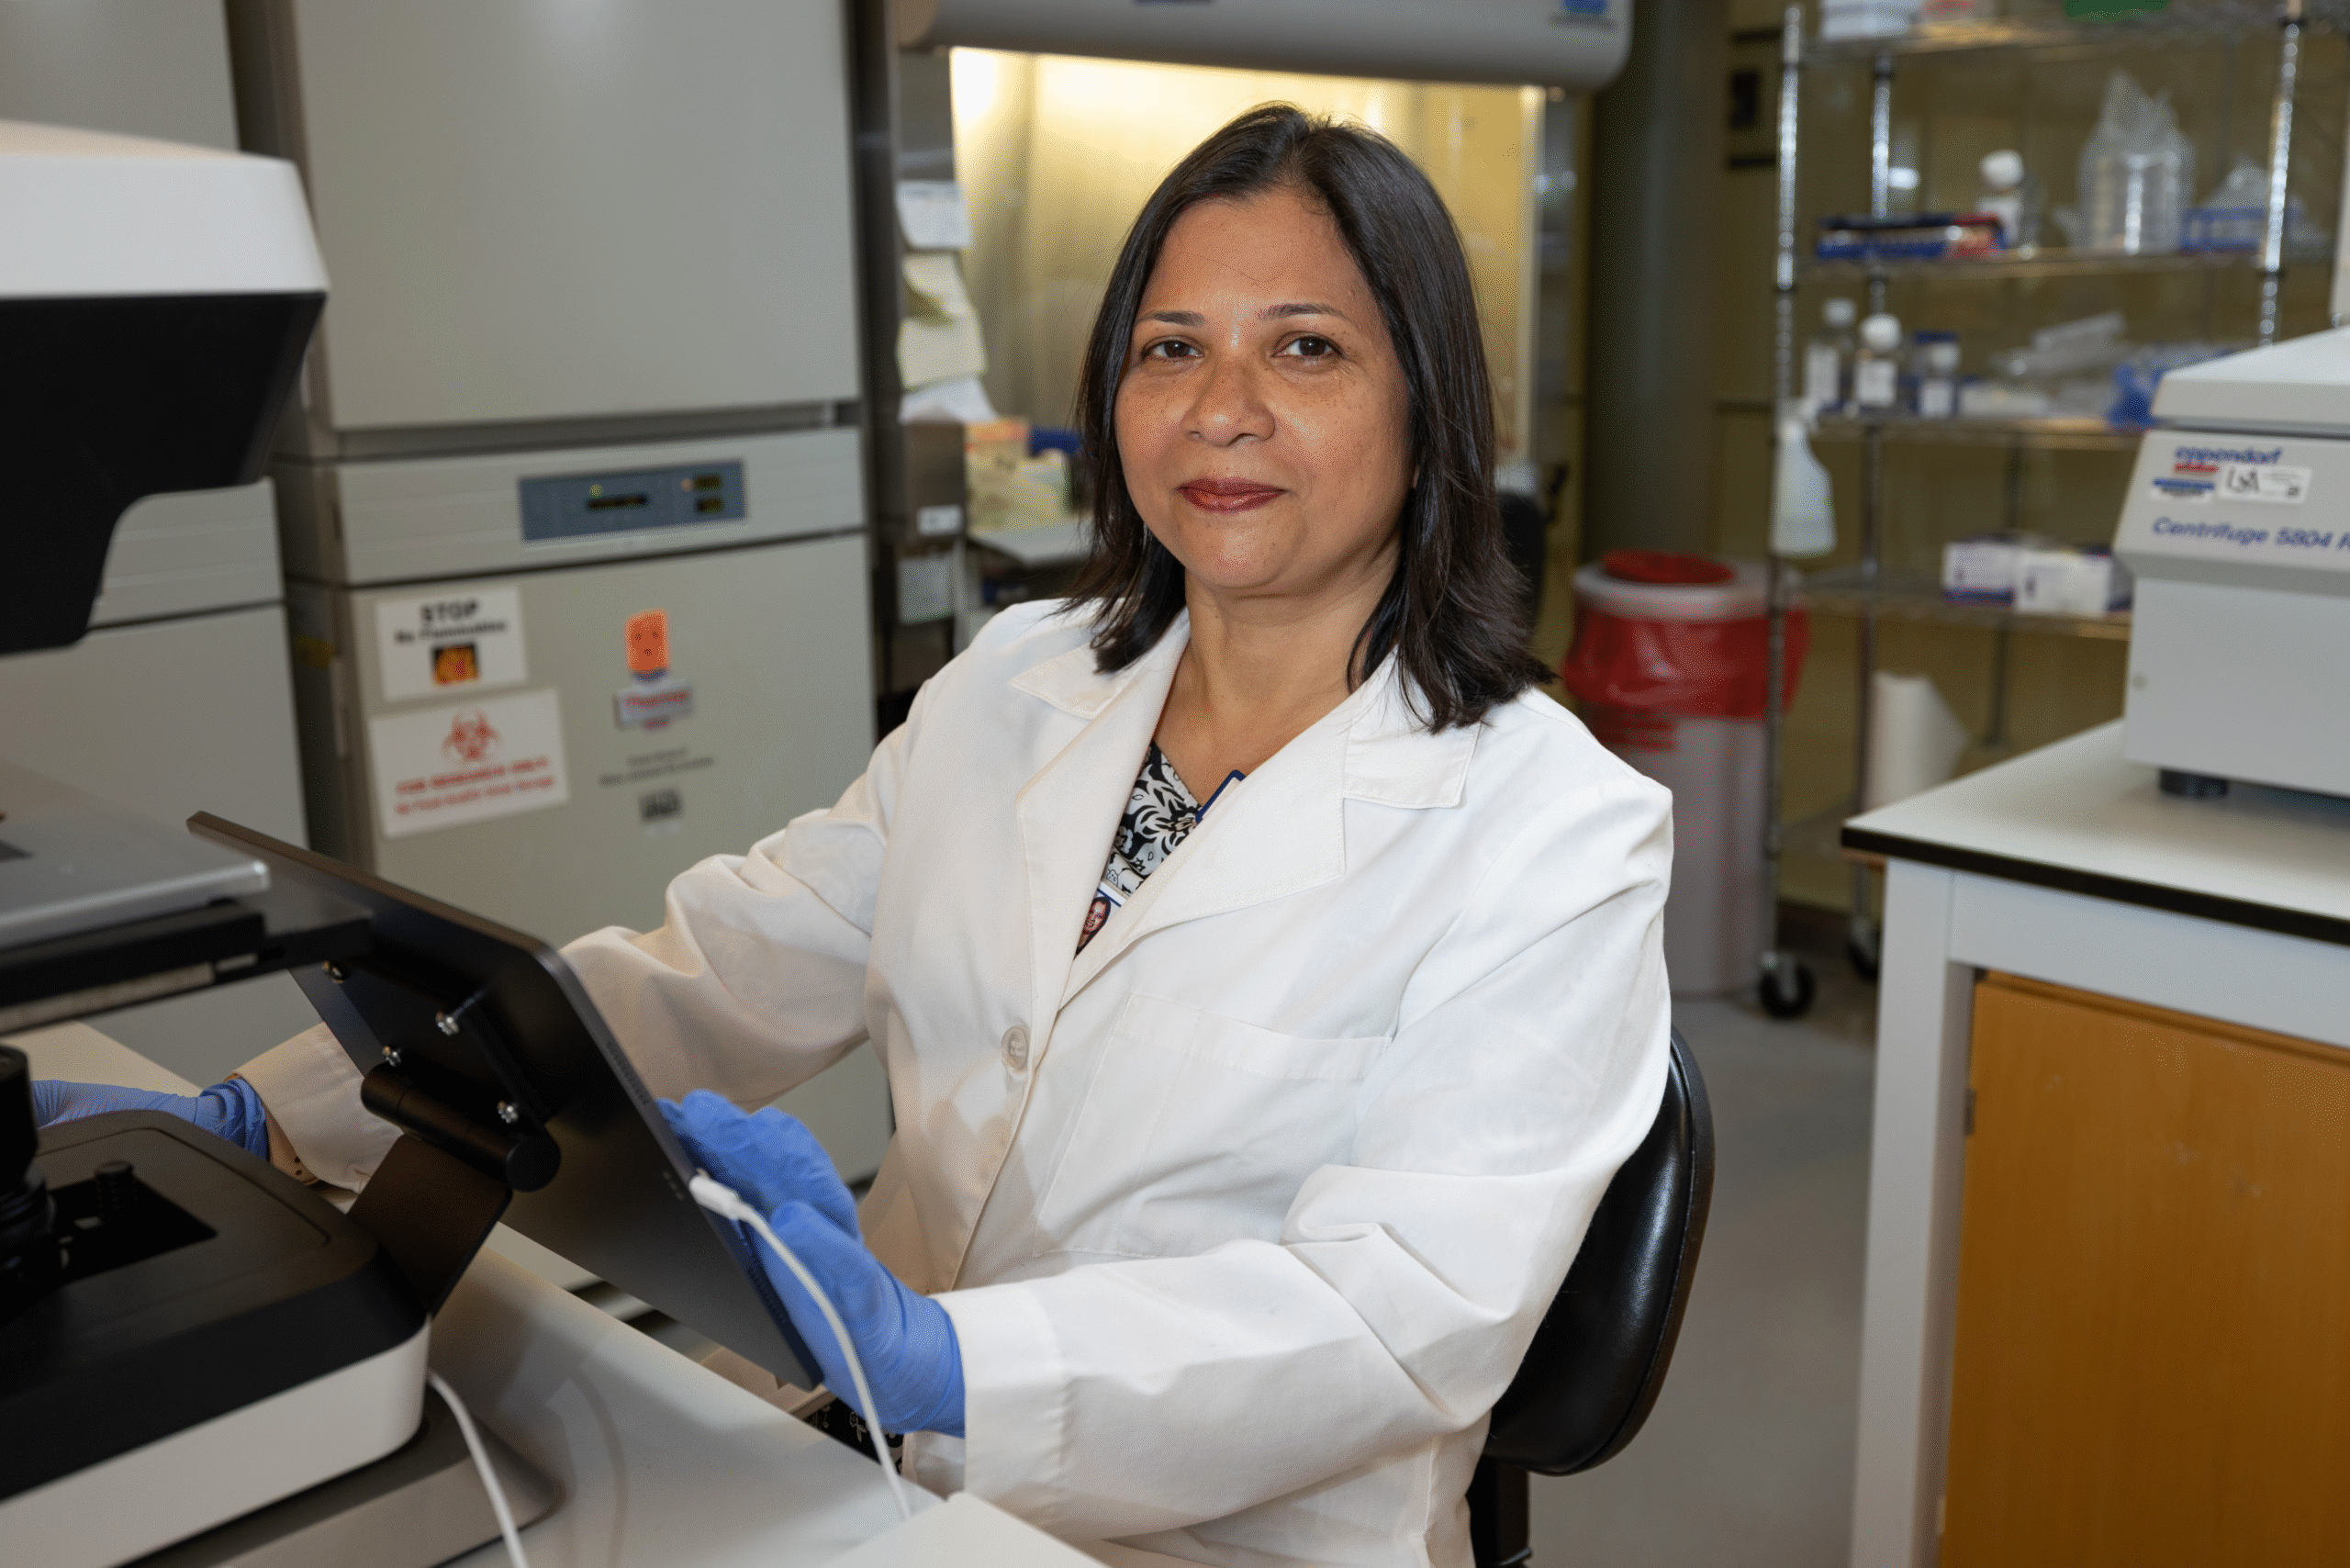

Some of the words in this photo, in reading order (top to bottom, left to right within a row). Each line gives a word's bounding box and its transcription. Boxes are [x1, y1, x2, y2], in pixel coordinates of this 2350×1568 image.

[2176, 446, 2282, 465] eppendorf
[2153, 517, 2269, 545] Centrifuge
[2275, 526, 2333, 547] 5804
[420, 599, 478, 622] STOP
